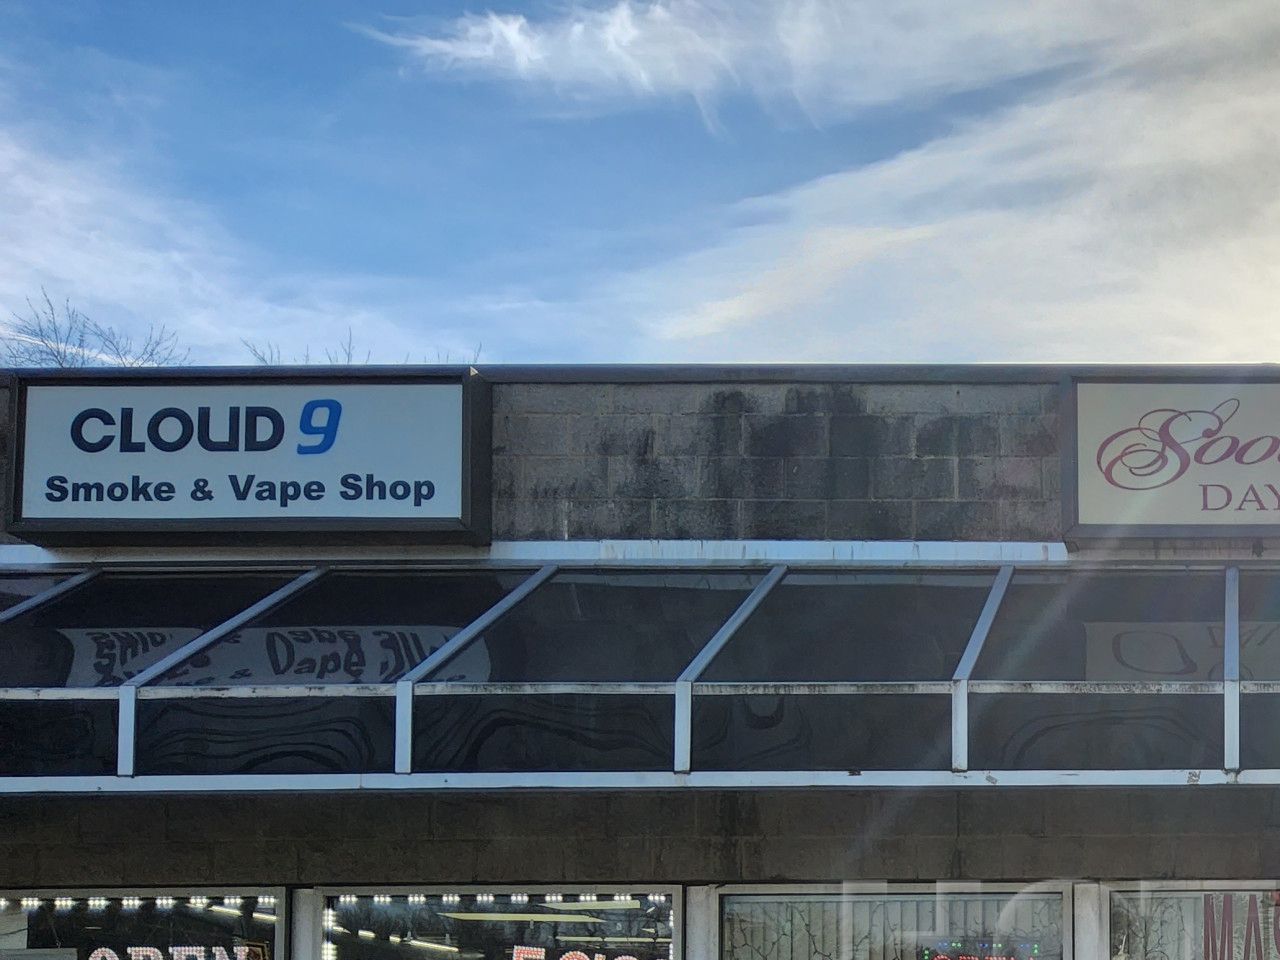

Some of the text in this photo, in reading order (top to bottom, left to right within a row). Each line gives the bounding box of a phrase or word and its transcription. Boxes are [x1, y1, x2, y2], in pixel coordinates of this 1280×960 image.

[70, 398, 343, 455] CLOUD 9
[45, 473, 436, 507] Smoke & Vape Shop
